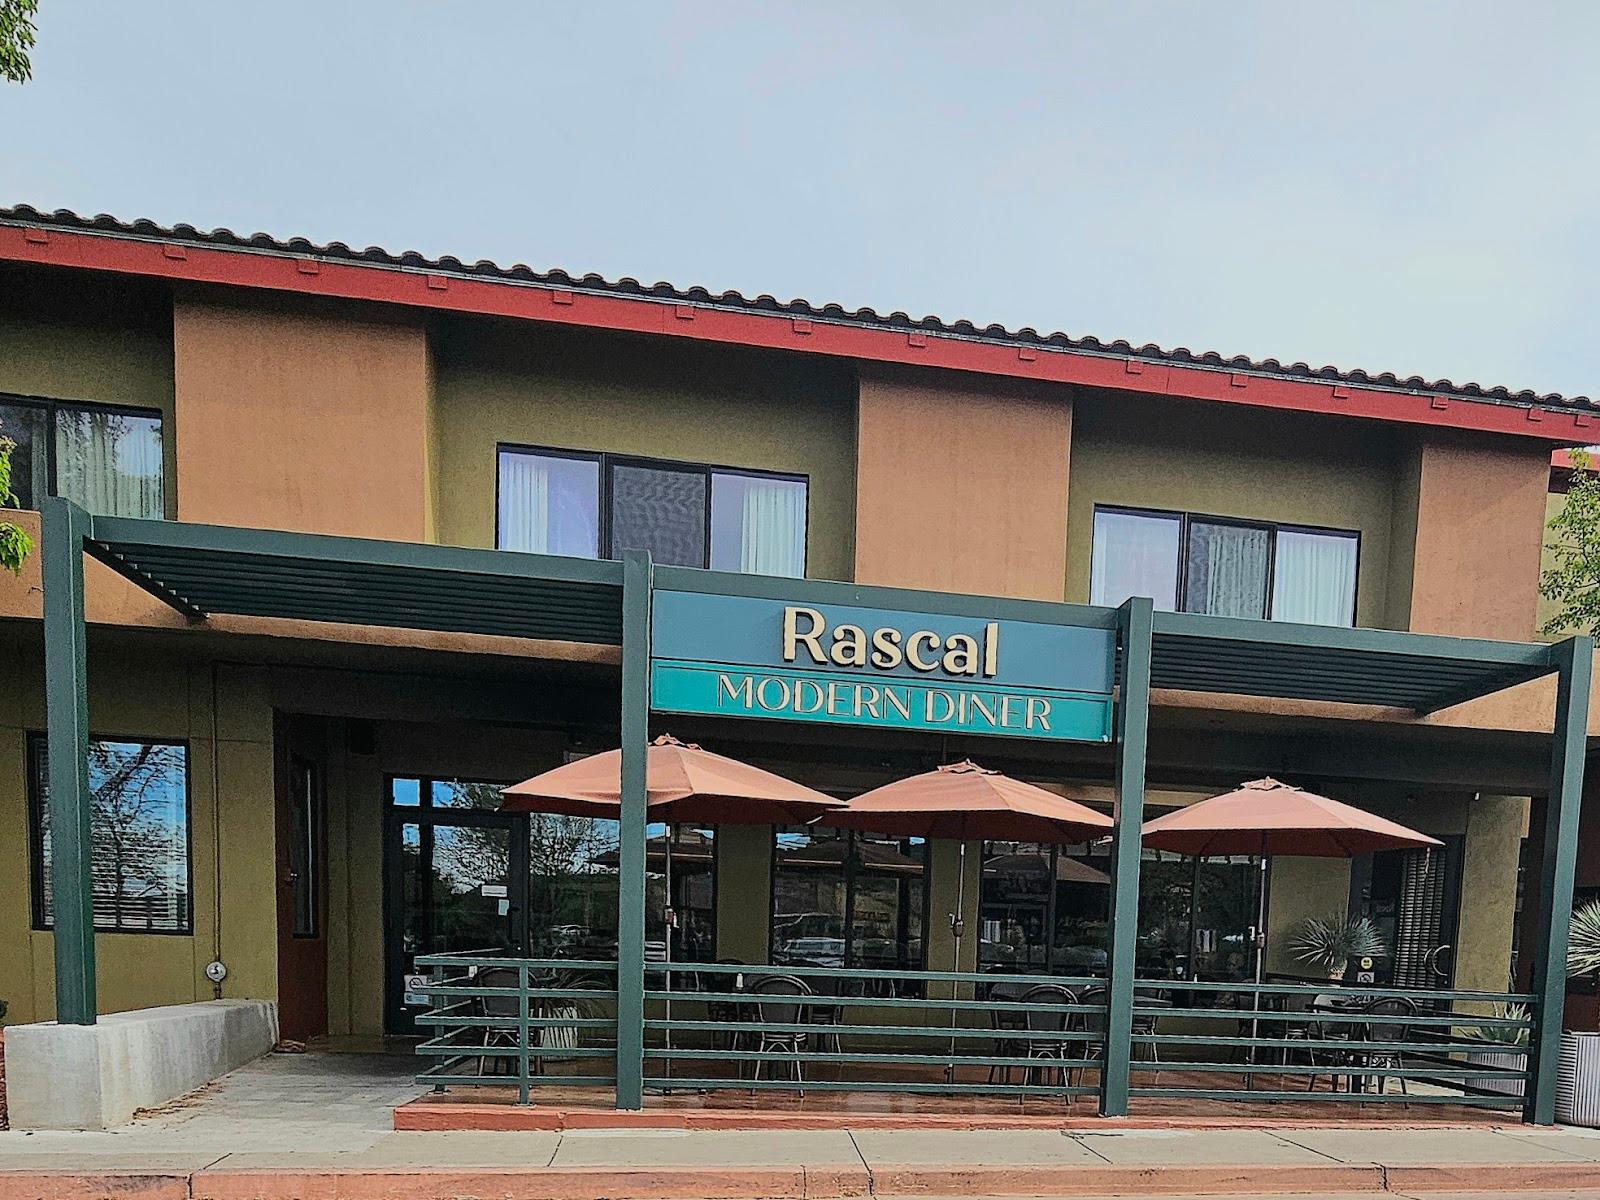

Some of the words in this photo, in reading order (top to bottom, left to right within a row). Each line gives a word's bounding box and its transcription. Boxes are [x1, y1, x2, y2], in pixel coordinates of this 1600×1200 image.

[783, 606, 998, 677] Rascal
[717, 674, 911, 721] MODERN
[925, 690, 1052, 731] DINER
